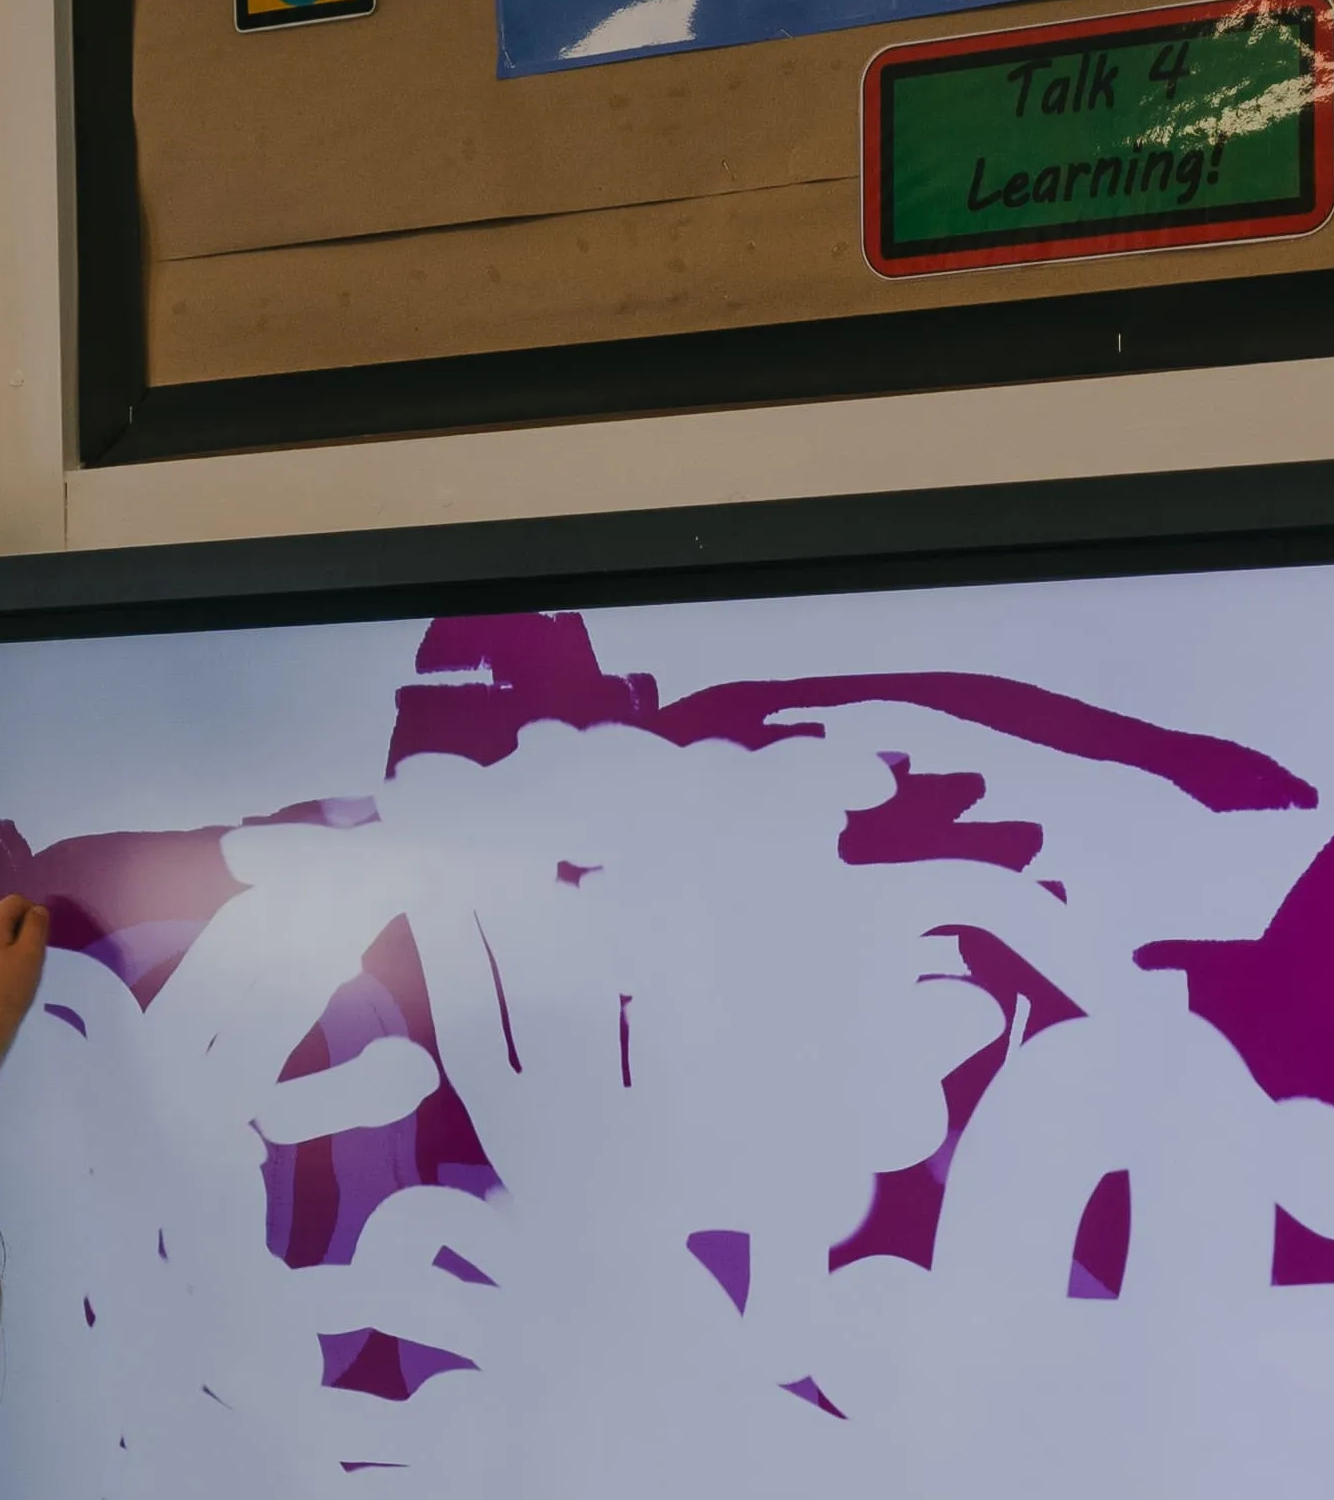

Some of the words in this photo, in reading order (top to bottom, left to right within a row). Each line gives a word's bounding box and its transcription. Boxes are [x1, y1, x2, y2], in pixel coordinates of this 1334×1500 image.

[1007, 52, 1119, 118] Talk
[1148, 41, 1191, 100] 4
[967, 131, 1227, 211] Learning!
